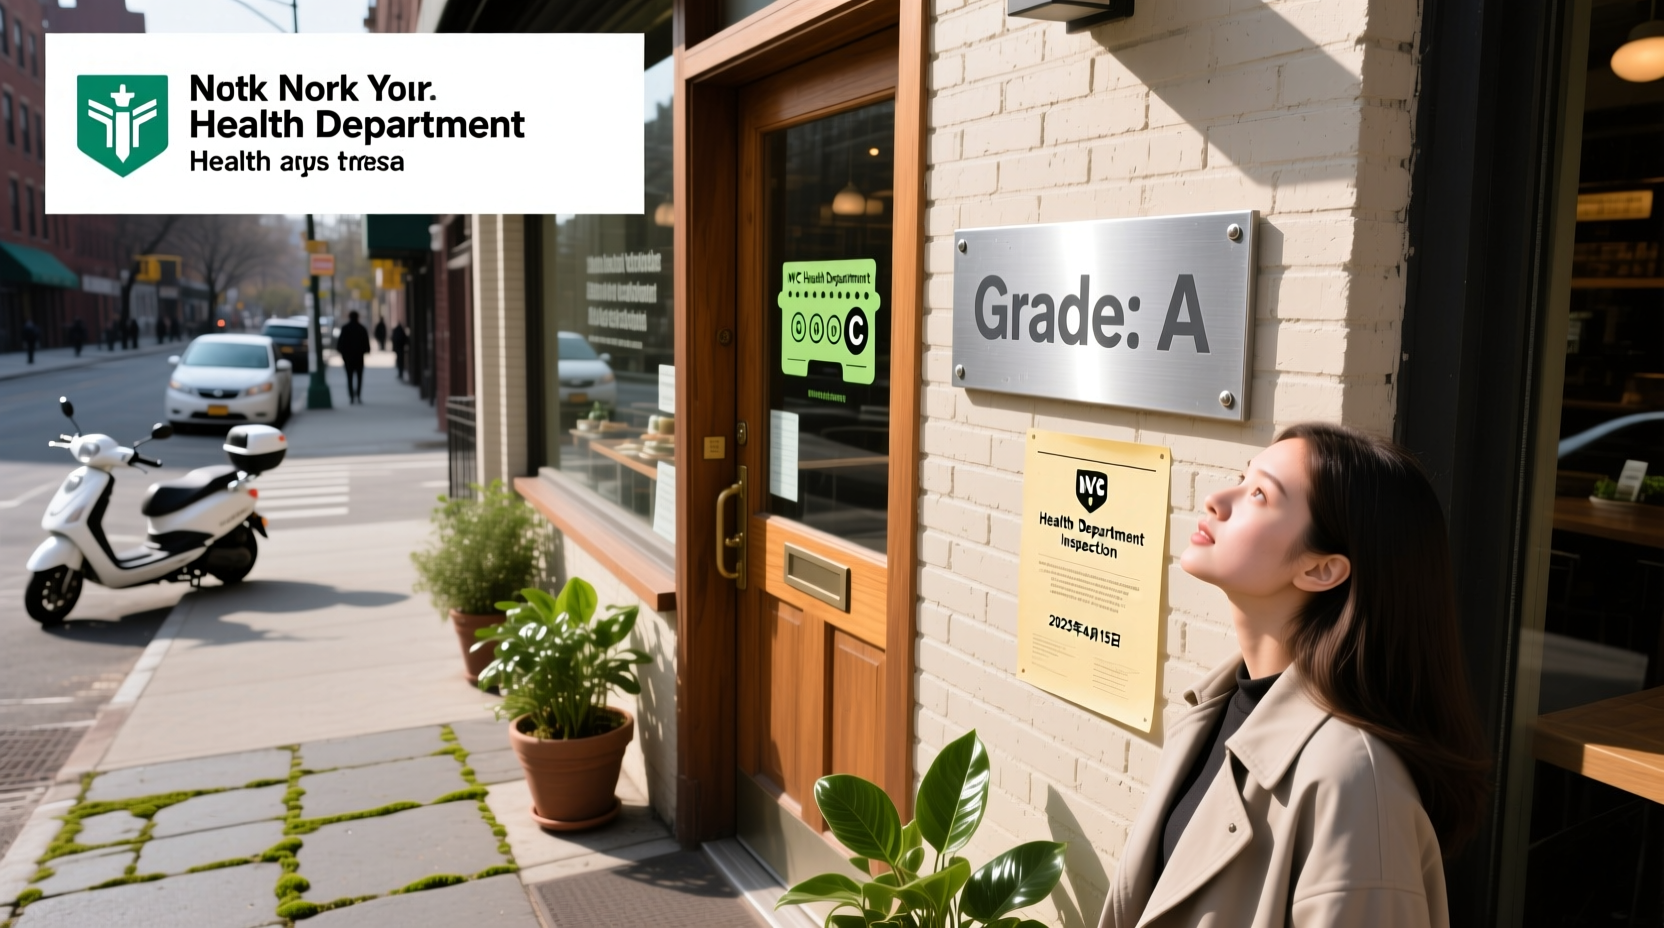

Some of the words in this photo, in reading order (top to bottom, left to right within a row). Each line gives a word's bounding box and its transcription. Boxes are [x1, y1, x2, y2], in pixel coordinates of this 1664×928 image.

[975, 274, 1141, 349] Grade:
[1156, 273, 1211, 353] A
[848, 314, 864, 346] C
[1039, 511, 1074, 530] Health
[1078, 517, 1145, 546] Department
[1061, 533, 1117, 559] Inspection
